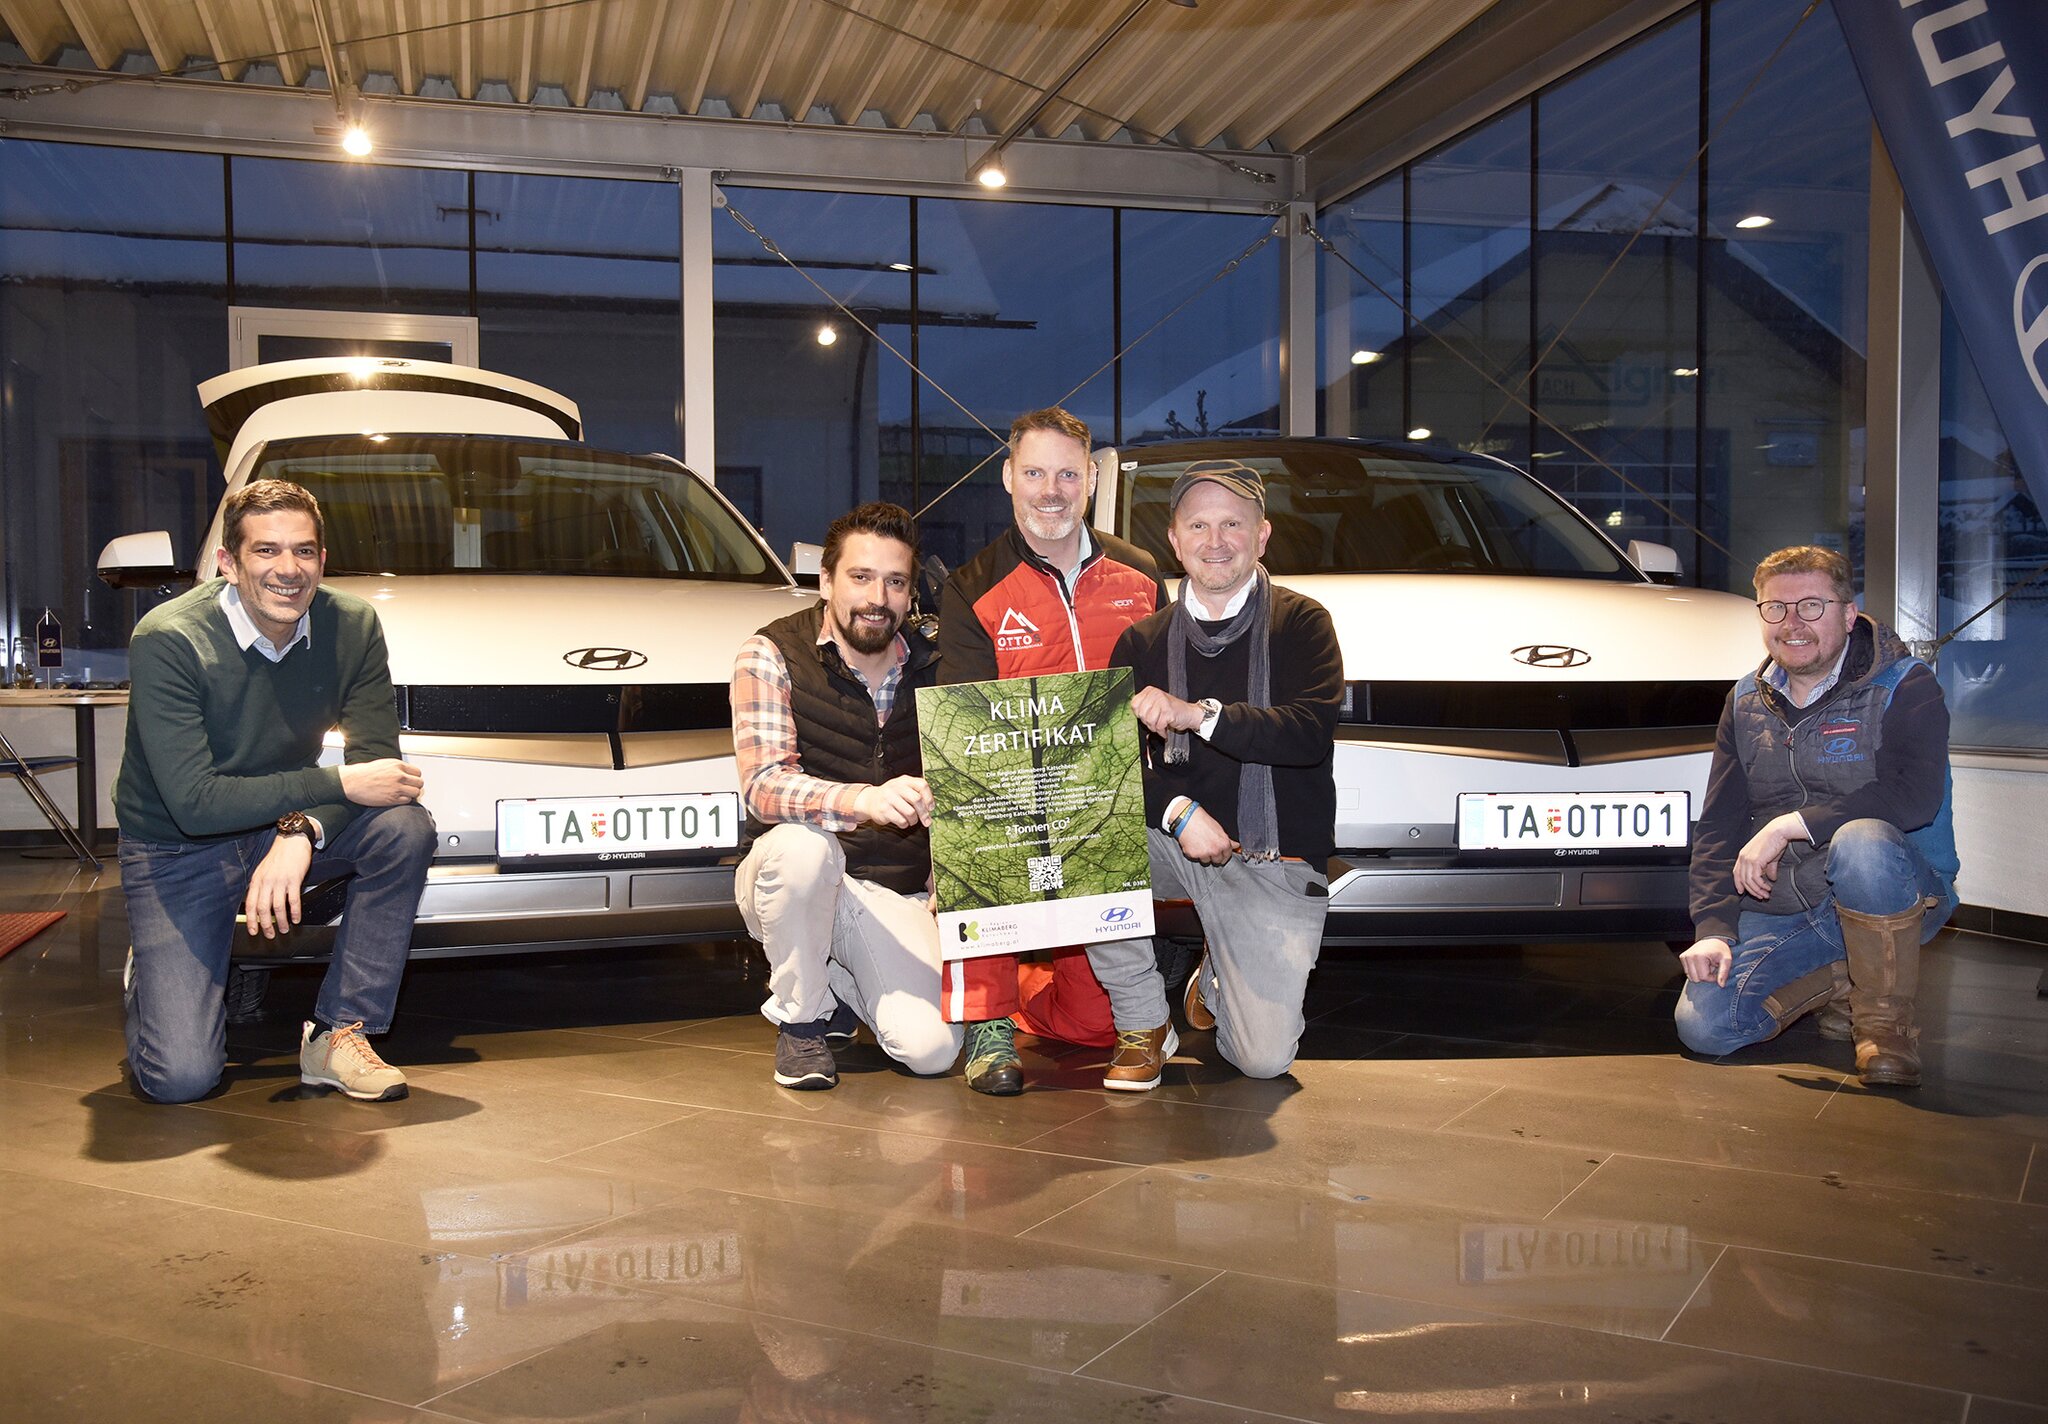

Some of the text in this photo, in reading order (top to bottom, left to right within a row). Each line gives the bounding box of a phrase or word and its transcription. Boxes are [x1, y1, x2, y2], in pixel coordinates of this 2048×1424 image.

[990, 695, 1065, 721] KLIMA
[963, 723, 1097, 756] ZERTIFIKAT
[1817, 753, 1865, 764] HYUNDAI
[539, 810, 583, 844] TA
[1005, 825, 1012, 835] 2
[1013, 822, 1050, 835] Tonnen
[1497, 804, 1540, 839] TA
[981, 923, 1018, 933] KLIMABERG
[1095, 922, 1141, 934] HYUNDAI
